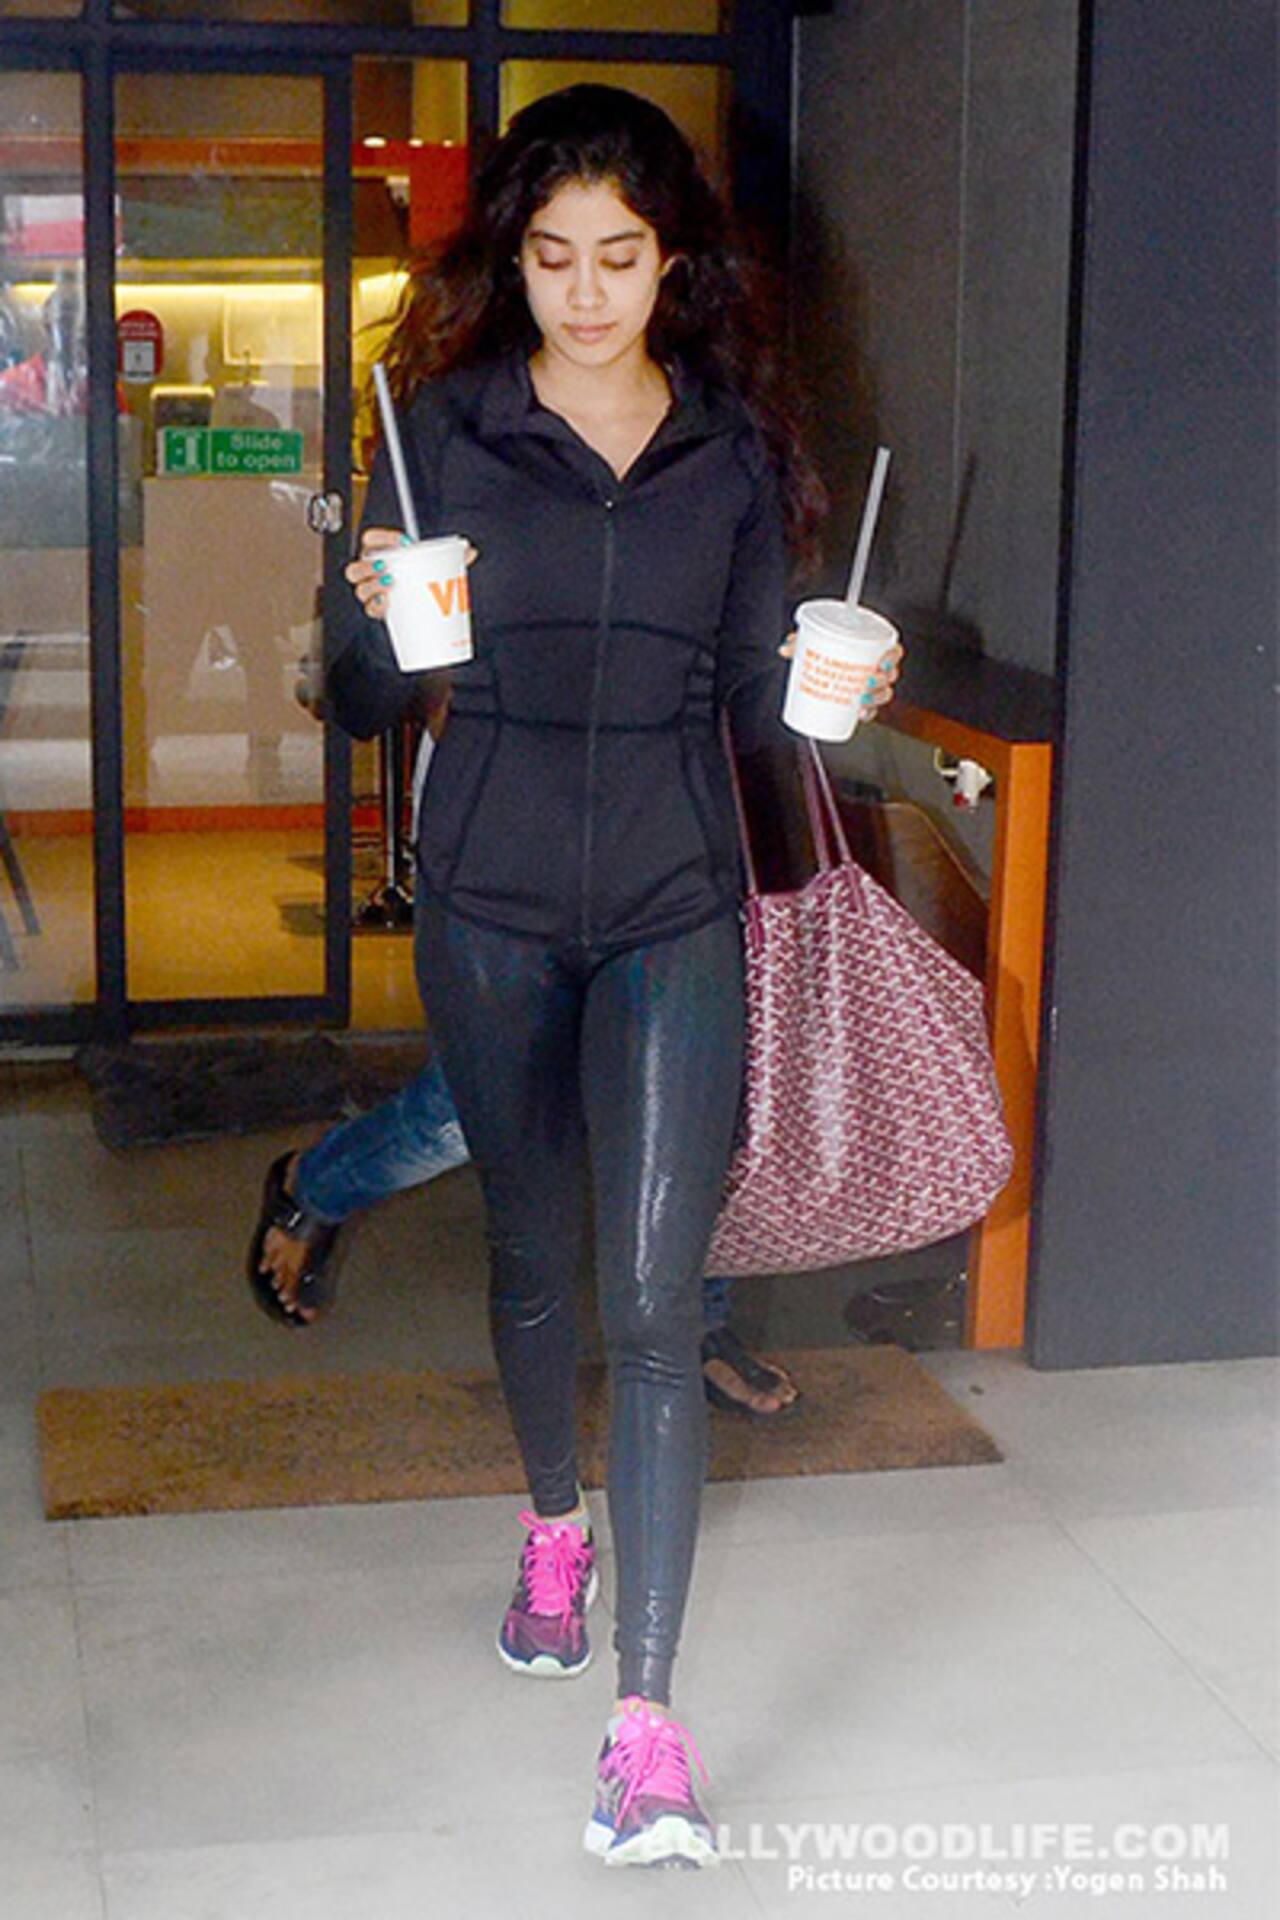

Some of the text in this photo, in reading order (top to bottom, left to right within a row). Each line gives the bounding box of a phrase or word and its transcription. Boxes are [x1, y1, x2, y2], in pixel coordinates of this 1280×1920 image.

[231, 433, 281, 450] Slide
[217, 451, 296, 472] to open
